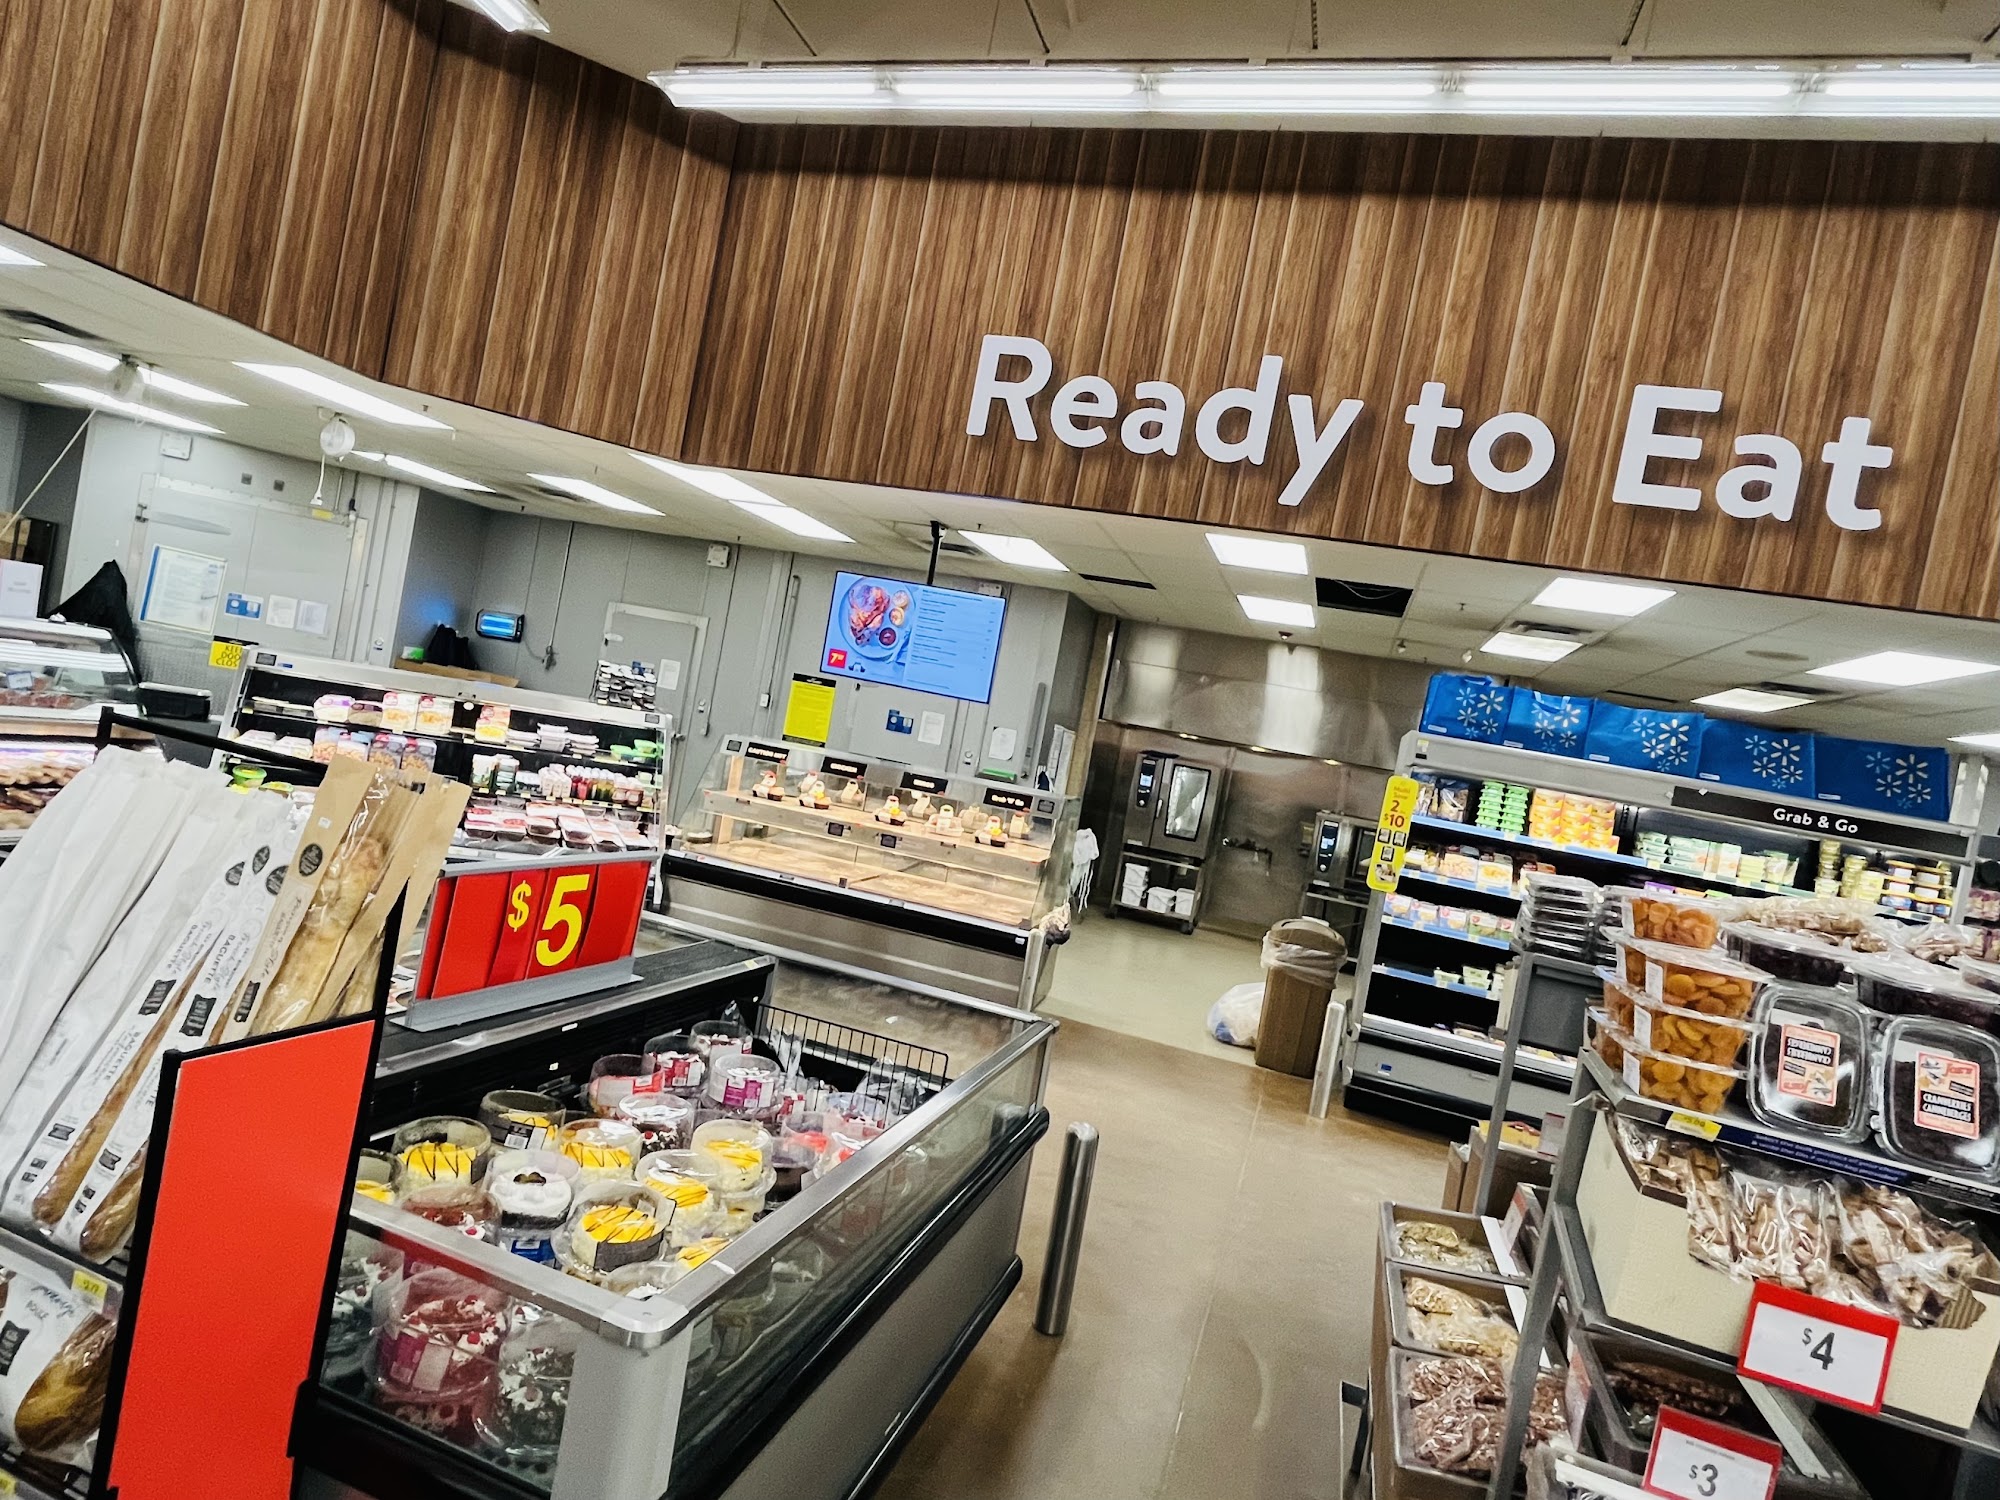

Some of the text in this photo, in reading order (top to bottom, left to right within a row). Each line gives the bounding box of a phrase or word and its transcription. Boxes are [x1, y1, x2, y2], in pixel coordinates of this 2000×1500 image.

[966, 334, 1894, 531] Ready to Eat
[1384, 813, 1405, 828] $10
[1390, 799, 1400, 812] 2
[1773, 808, 1858, 833] Grab & Go
[507, 874, 590, 967] $5
[202, 932, 235, 985] BAGUETTE
[1801, 1327, 1835, 1371] $4
[1688, 1463, 1719, 1497] $3
